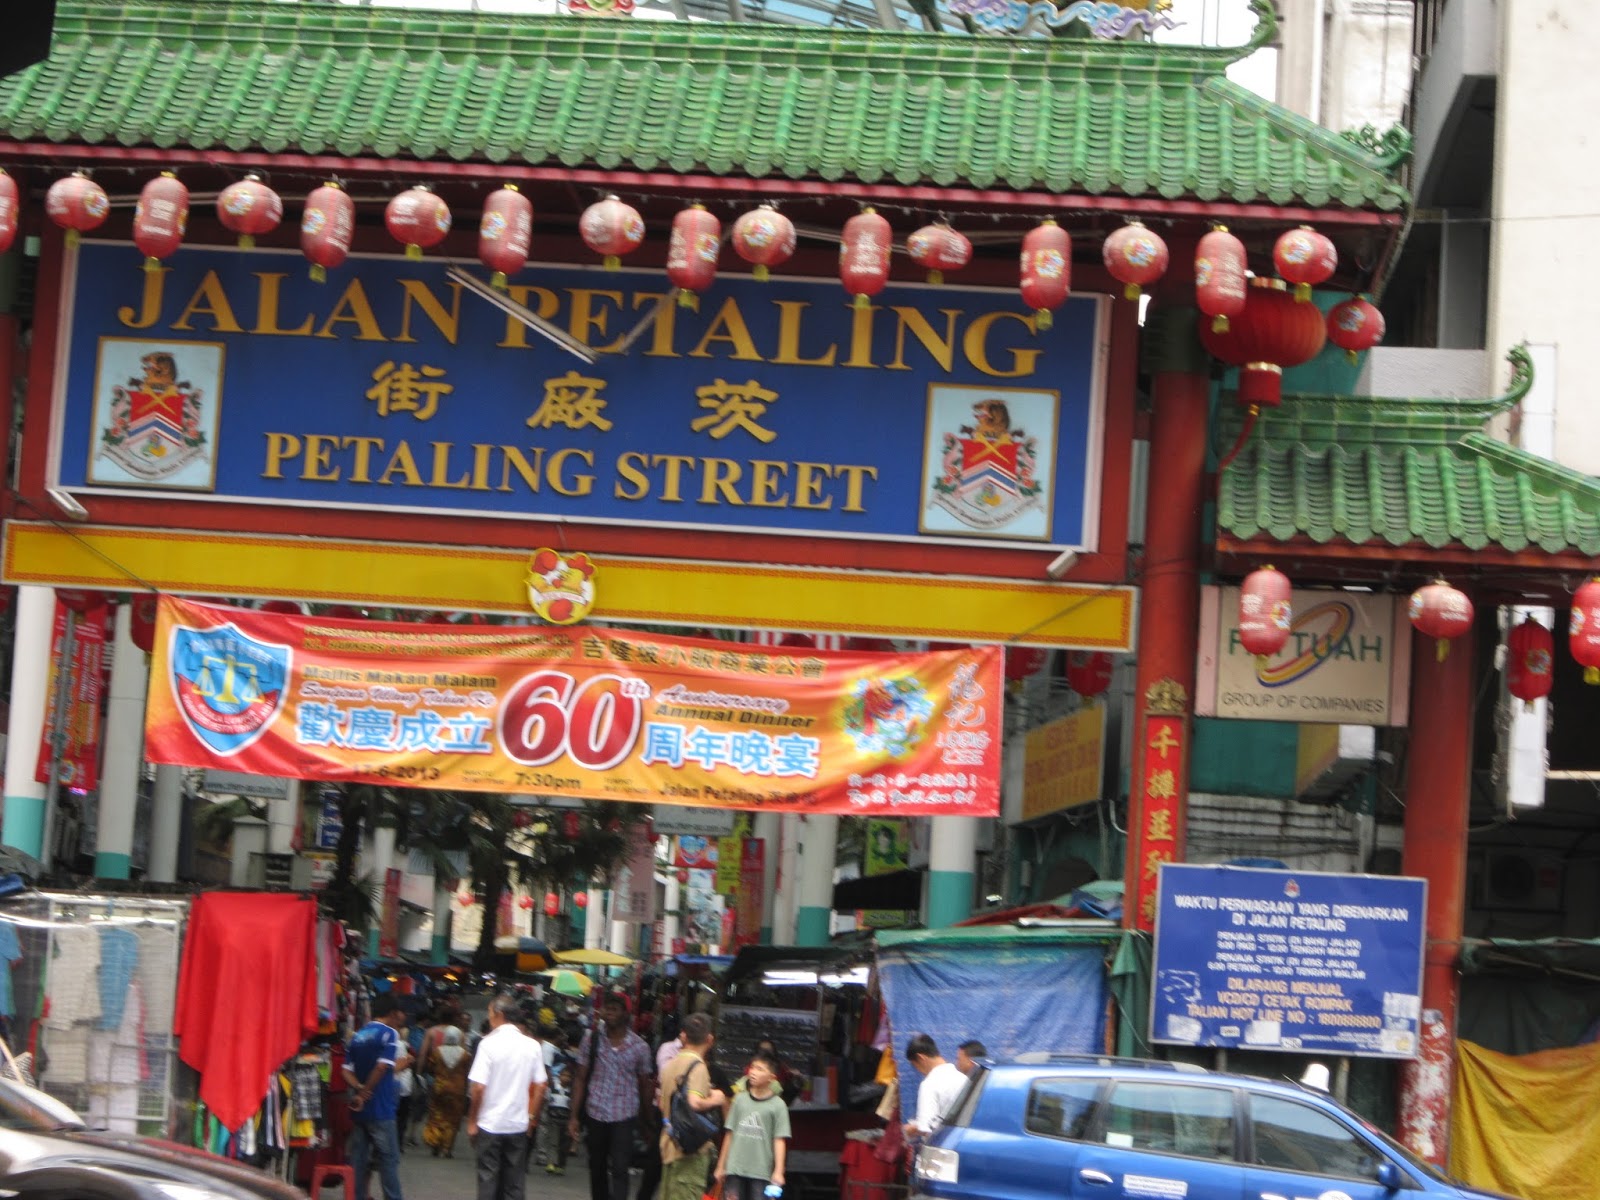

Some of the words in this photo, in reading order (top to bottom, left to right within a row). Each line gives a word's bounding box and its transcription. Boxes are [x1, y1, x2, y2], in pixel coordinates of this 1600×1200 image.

[117, 265, 462, 345] JALAN
[497, 285, 1045, 378] PETALING
[263, 431, 598, 496] PETALING
[613, 451, 878, 513] STREET
[304, 665, 361, 681] Majlis
[366, 670, 429, 685] Makan
[435, 673, 497, 688] Malam
[1223, 691, 1272, 707] GROUP
[1277, 694, 1297, 709] OF
[1301, 694, 1384, 713] COMPANIES
[299, 702, 492, 752] 歡慶成立
[656, 704, 733, 723] Annual
[739, 711, 816, 728] Dinner
[643, 723, 818, 777] 周年晚宴
[515, 771, 581, 790] 7:30pm
[1174, 895, 1217, 910] WAKTU
[1297, 902, 1330, 917] YANG
[1332, 904, 1408, 922] DIBENARKAN
[1232, 912, 1246, 925] DI
[1248, 913, 1288, 929] JALAN
[1290, 917, 1346, 932] PETALING
[1228, 977, 1288, 994] DILARANG
[1290, 980, 1345, 997] MENJUAL
[1187, 1003, 1228, 1019] TALIAN
[1231, 1005, 1256, 1021] HOT
[1259, 1008, 1285, 1023] LINE
[1263, 993, 1301, 1009] CETAK
[1304, 996, 1353, 1012] ROMPAK
